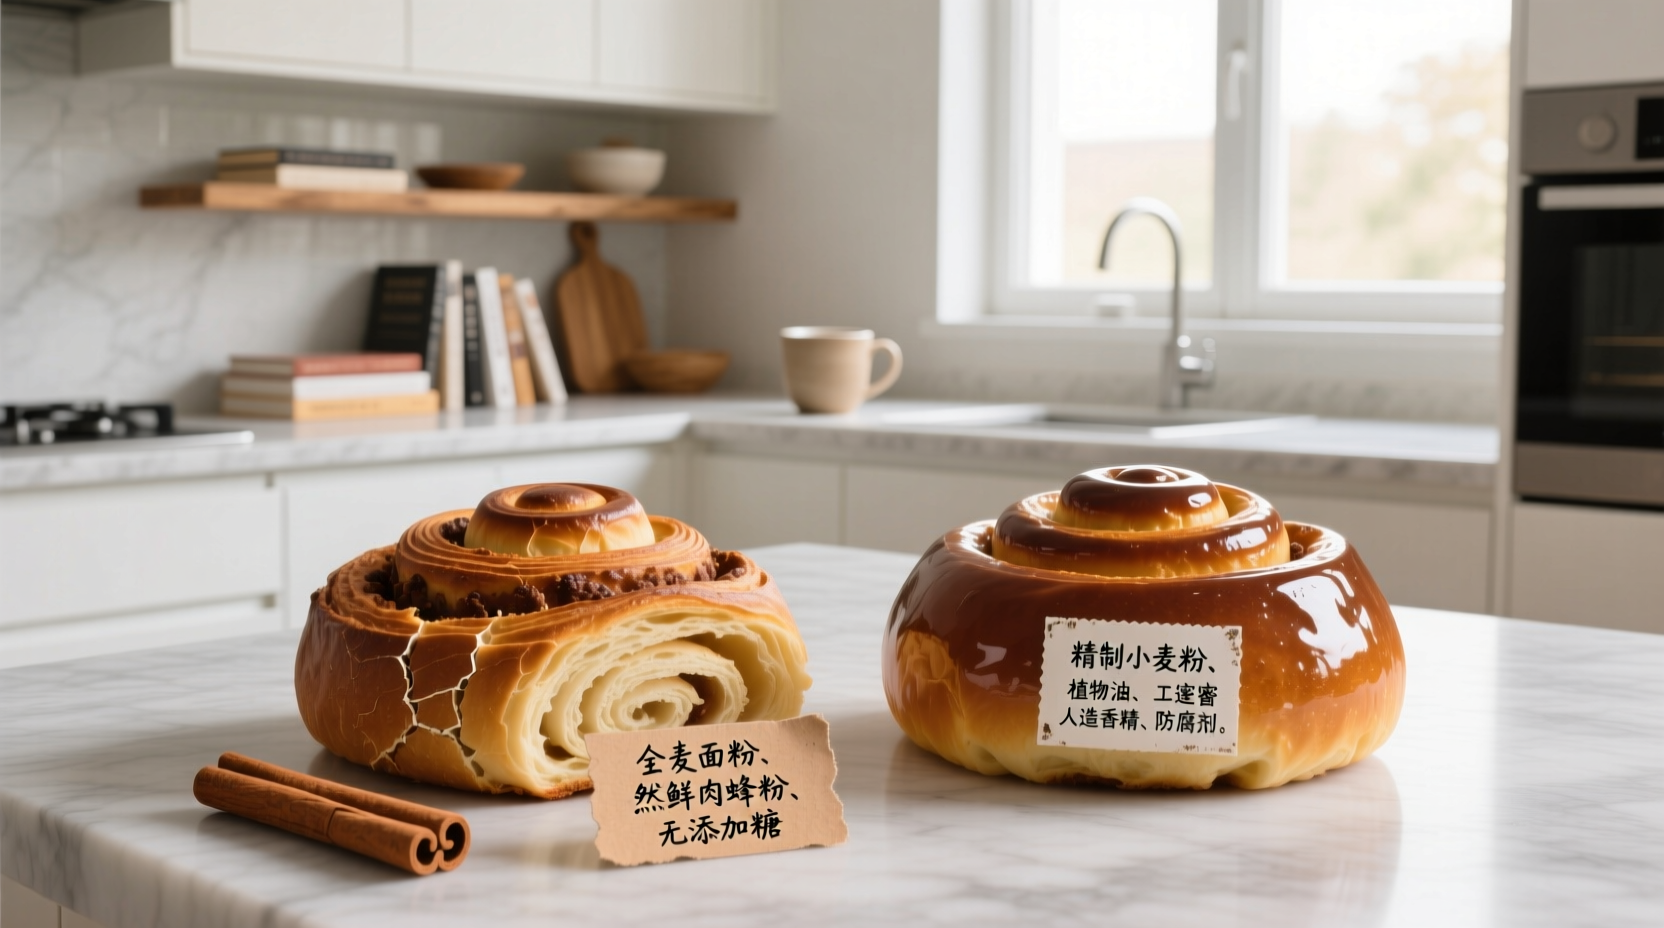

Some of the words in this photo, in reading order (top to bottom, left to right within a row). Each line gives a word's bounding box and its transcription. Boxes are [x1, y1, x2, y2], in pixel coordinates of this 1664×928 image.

[1071, 640, 1215, 673] 精制小麦粉、
[636, 739, 769, 776] 全麦面粉、
[658, 808, 783, 847] 无添加糖
